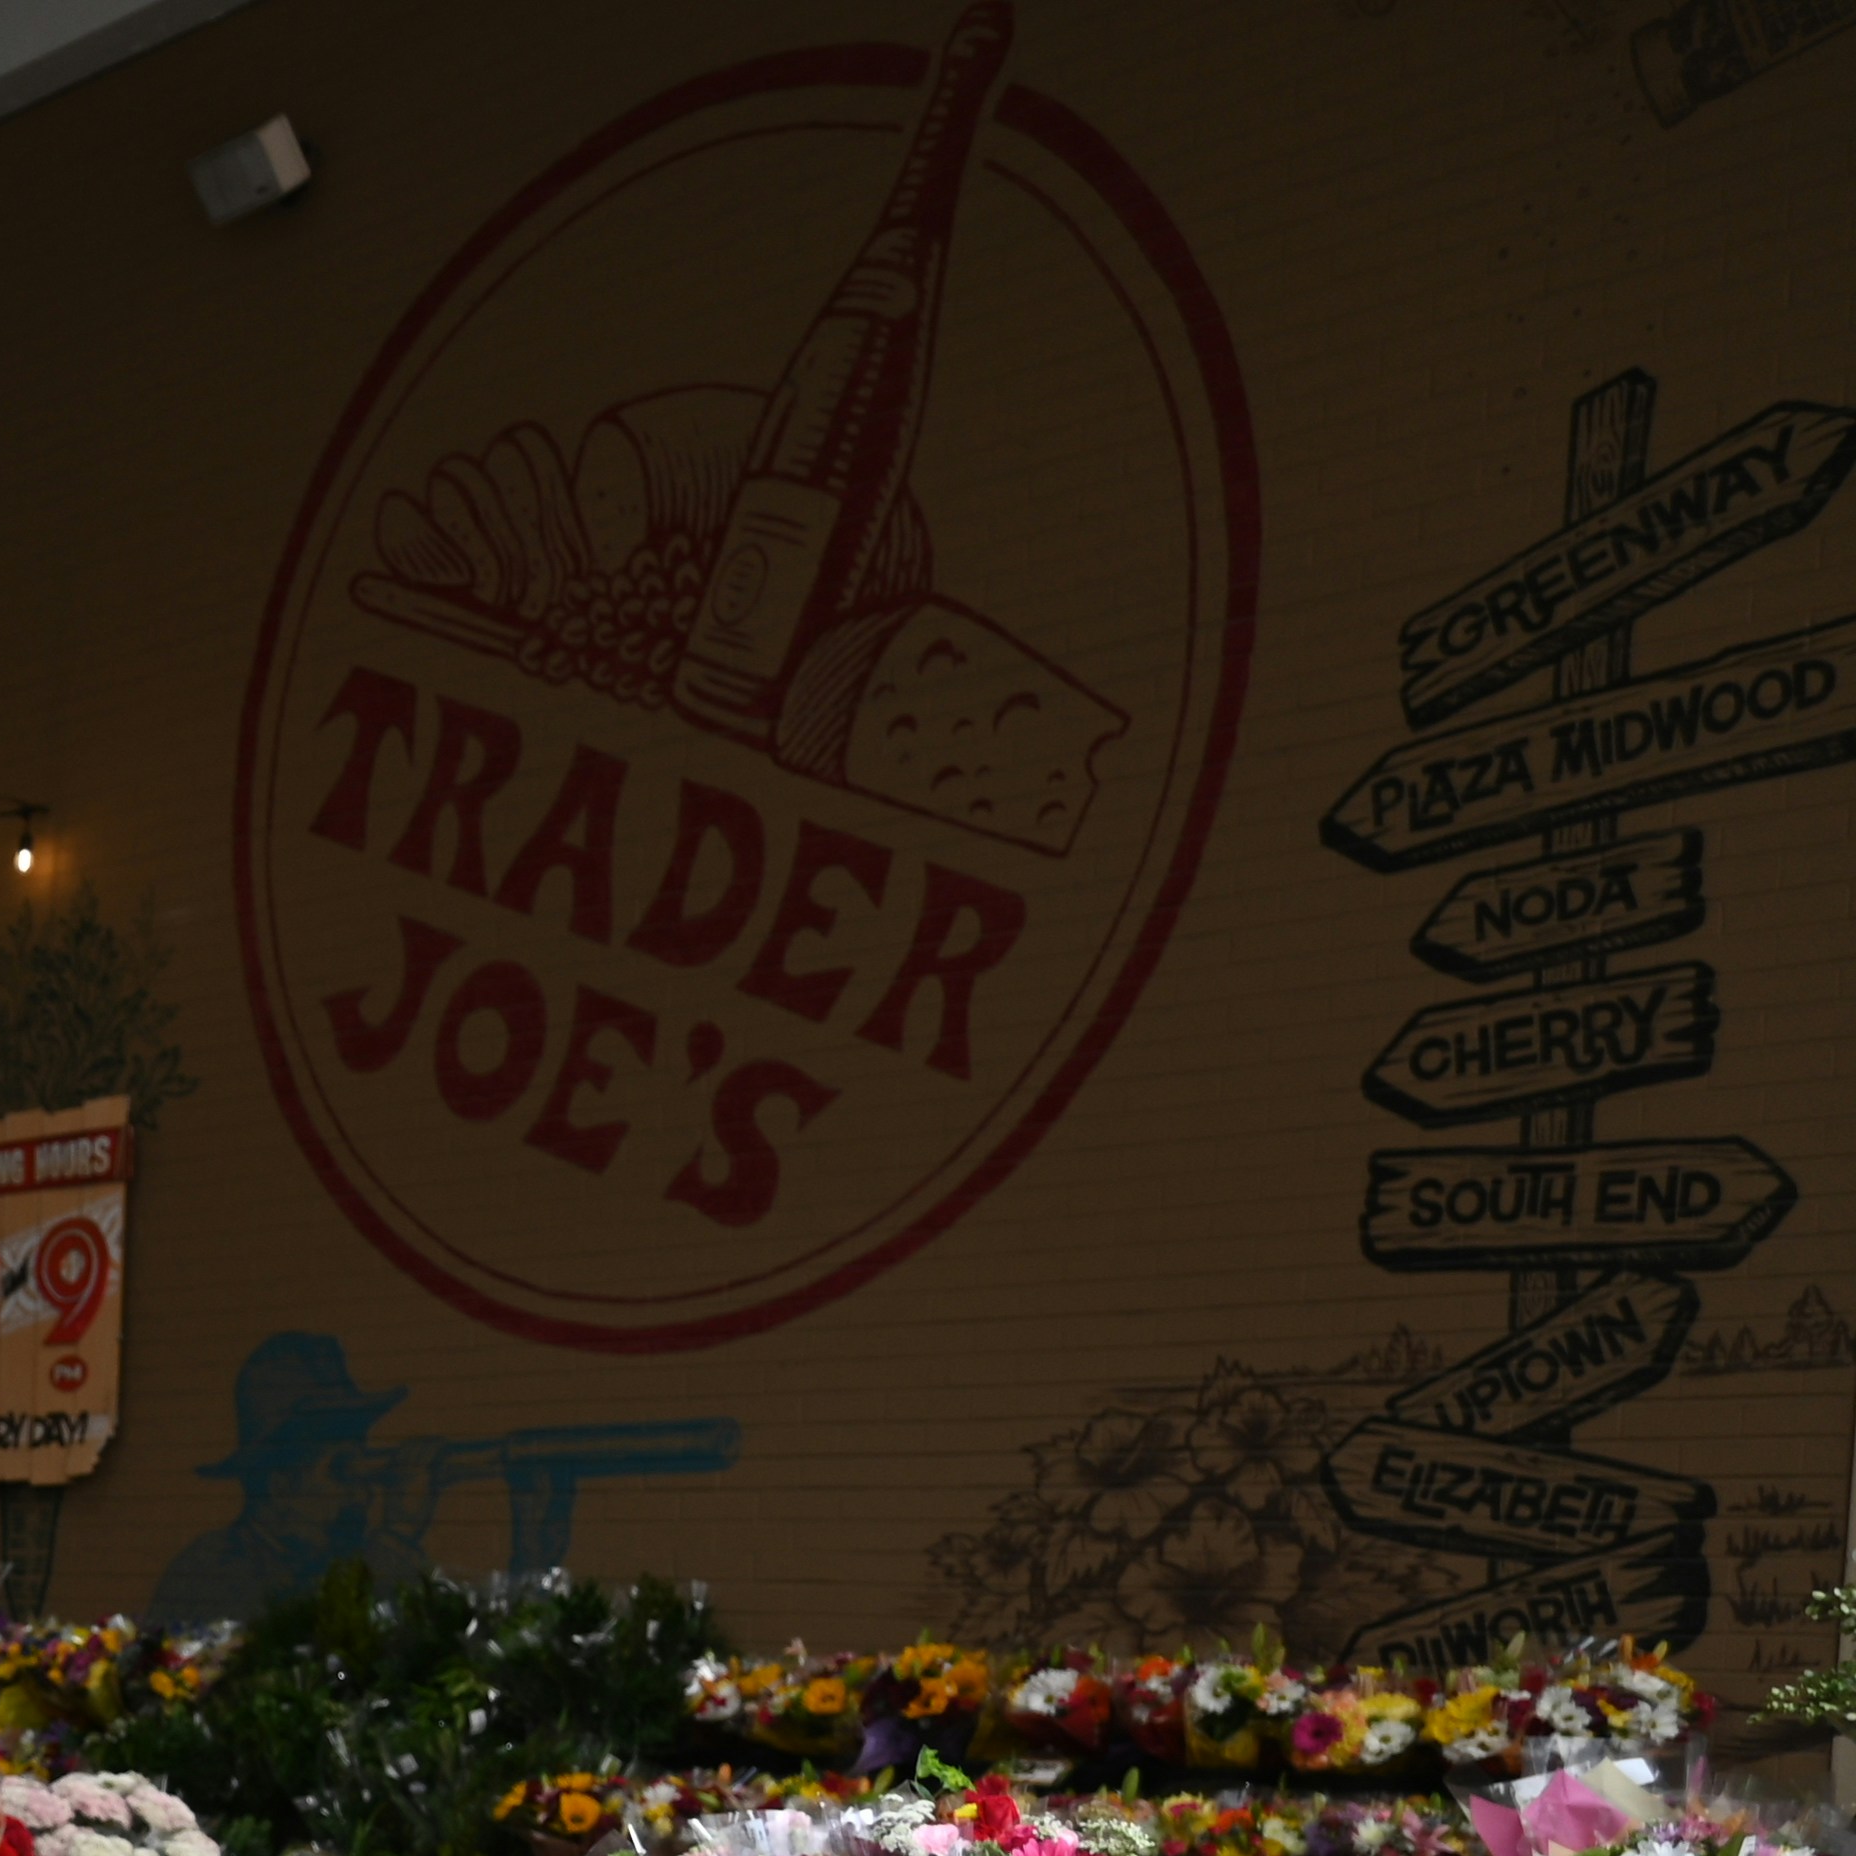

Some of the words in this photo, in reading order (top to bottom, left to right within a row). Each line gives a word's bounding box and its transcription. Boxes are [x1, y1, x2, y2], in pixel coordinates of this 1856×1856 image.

[1437, 426, 1798, 658] GREENWAY
[1371, 740, 1535, 830] PLAZA
[1550, 658, 1836, 781] MIDWOOD
[309, 666, 1026, 1081] TRADER
[1476, 864, 1638, 941] NODA
[321, 915, 842, 1227] JOE'S
[1409, 988, 1665, 1080] CHERRY
[34, 1136, 111, 1182] HOURS
[1410, 1164, 1574, 1228] SOUTH
[1595, 1166, 1721, 1225] END
[36, 1218, 109, 1345] 9
[1435, 1296, 1647, 1433] UPTOWN
[32, 1411, 89, 1446] DAY!
[1371, 1448, 1639, 1541] ELIZABETH
[1380, 1572, 1619, 1668] DILWORTH
